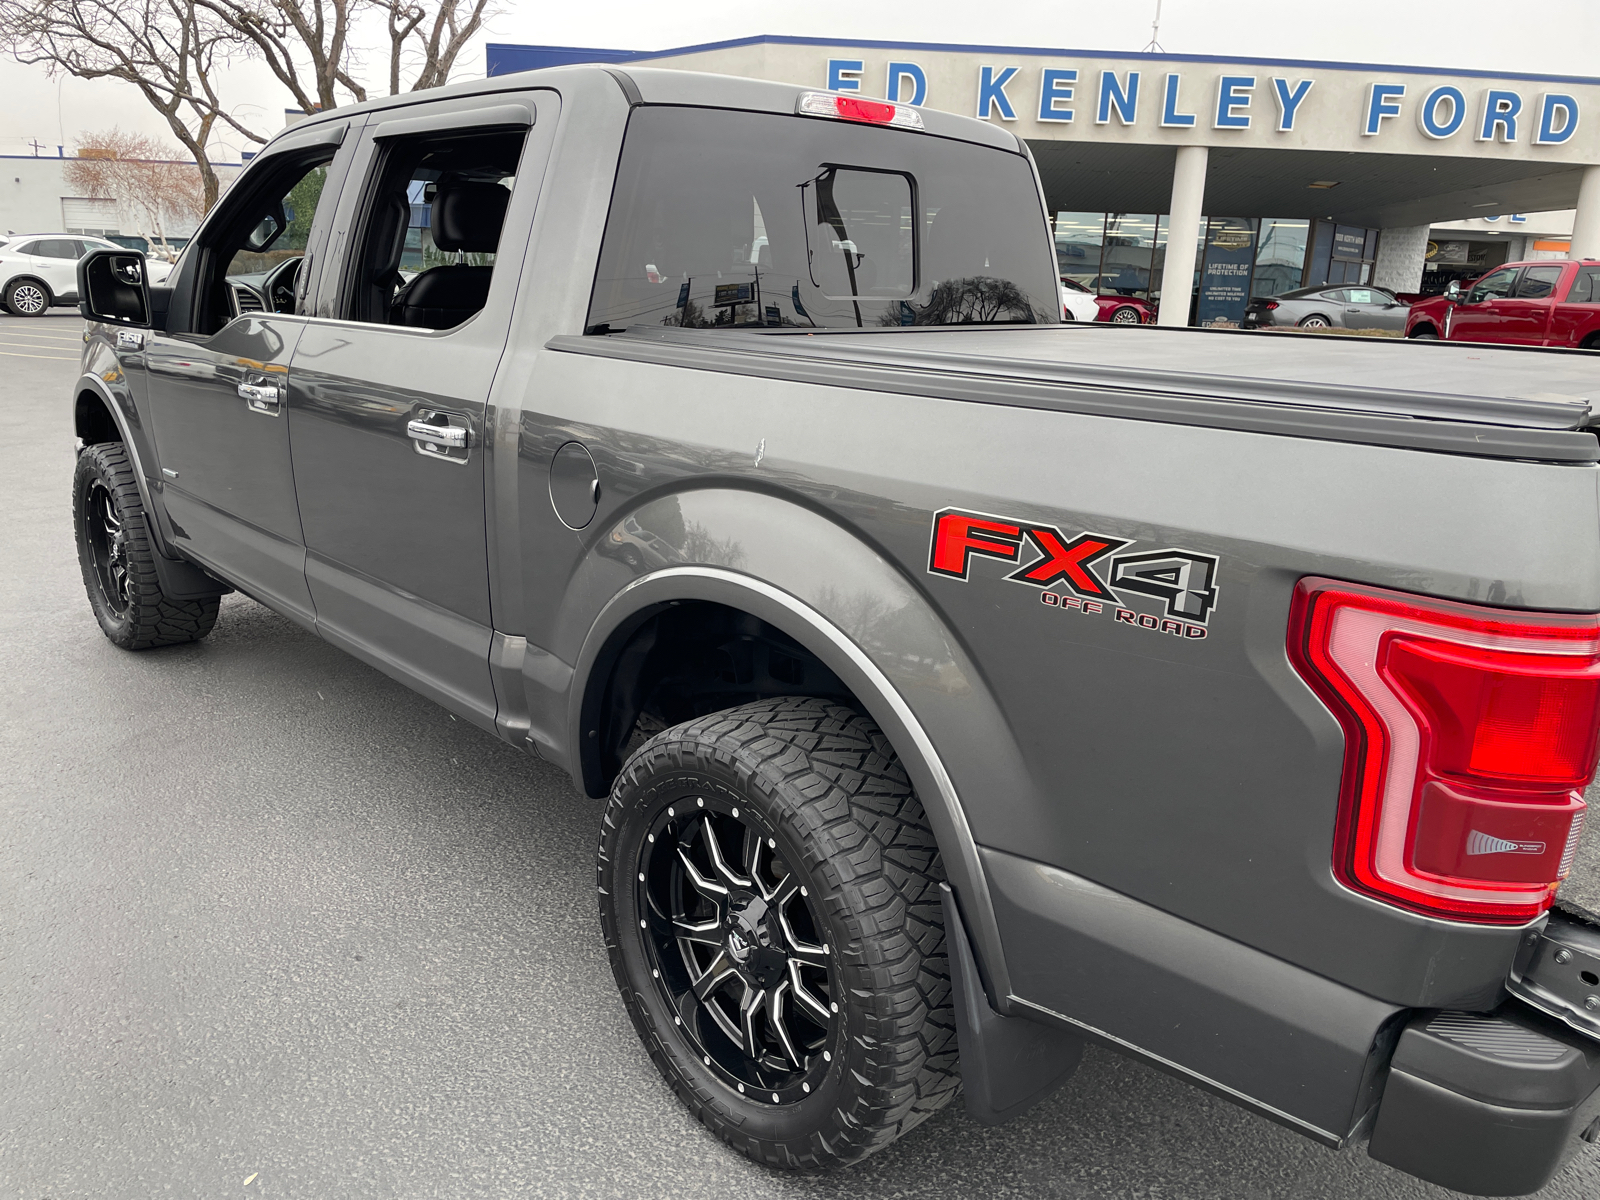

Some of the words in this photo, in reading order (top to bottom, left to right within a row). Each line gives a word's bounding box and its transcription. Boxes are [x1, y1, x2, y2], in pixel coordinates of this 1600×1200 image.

[826, 58, 928, 107] ED
[976, 65, 1315, 131] KENLEY
[1361, 82, 1580, 145] FORD
[927, 506, 1220, 626] FX4
[1040, 591, 1103, 615] OFF
[1114, 607, 1208, 640] ROAD
